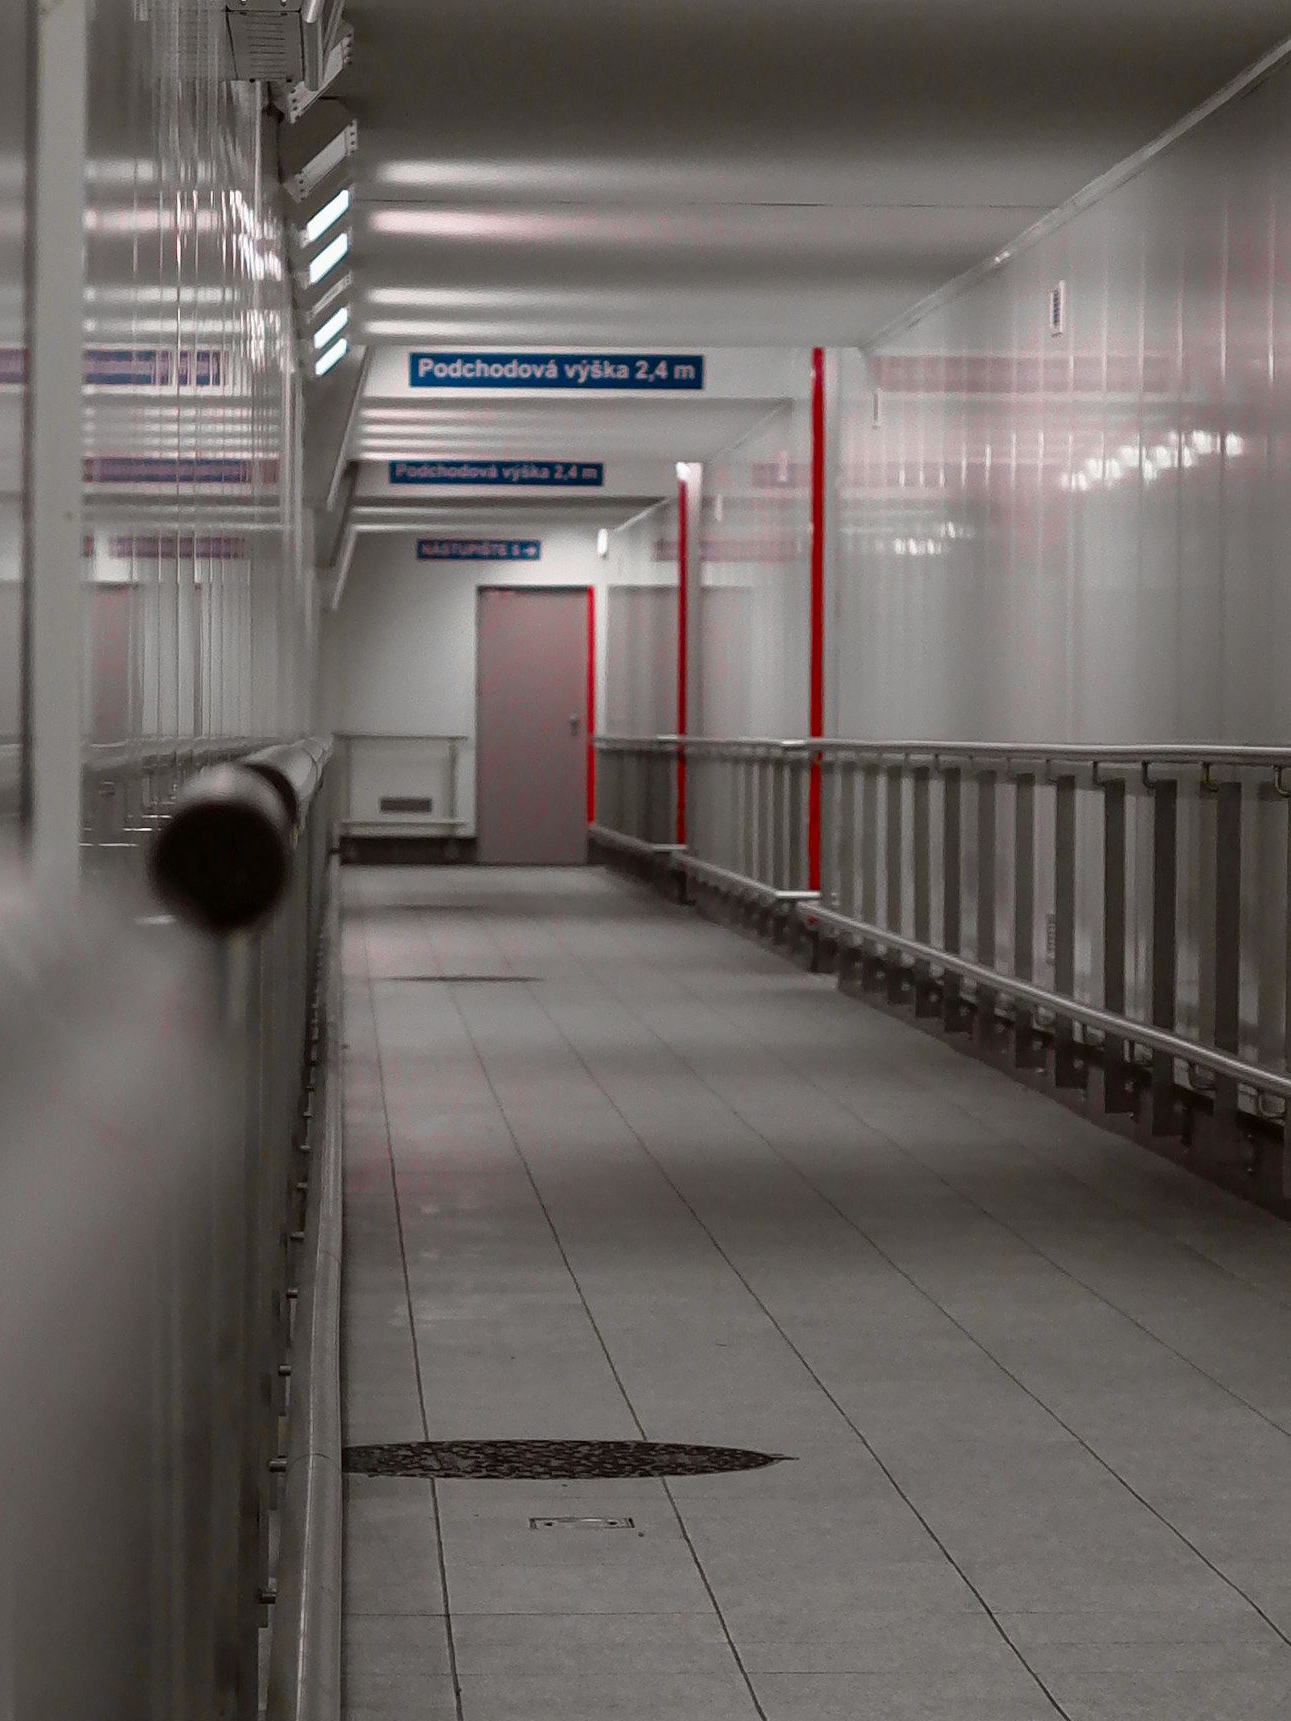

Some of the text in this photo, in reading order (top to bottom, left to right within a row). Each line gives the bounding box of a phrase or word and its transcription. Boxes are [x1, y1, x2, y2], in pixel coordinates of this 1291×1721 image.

[418, 357, 695, 384] Podchodová výška 2,4 m
